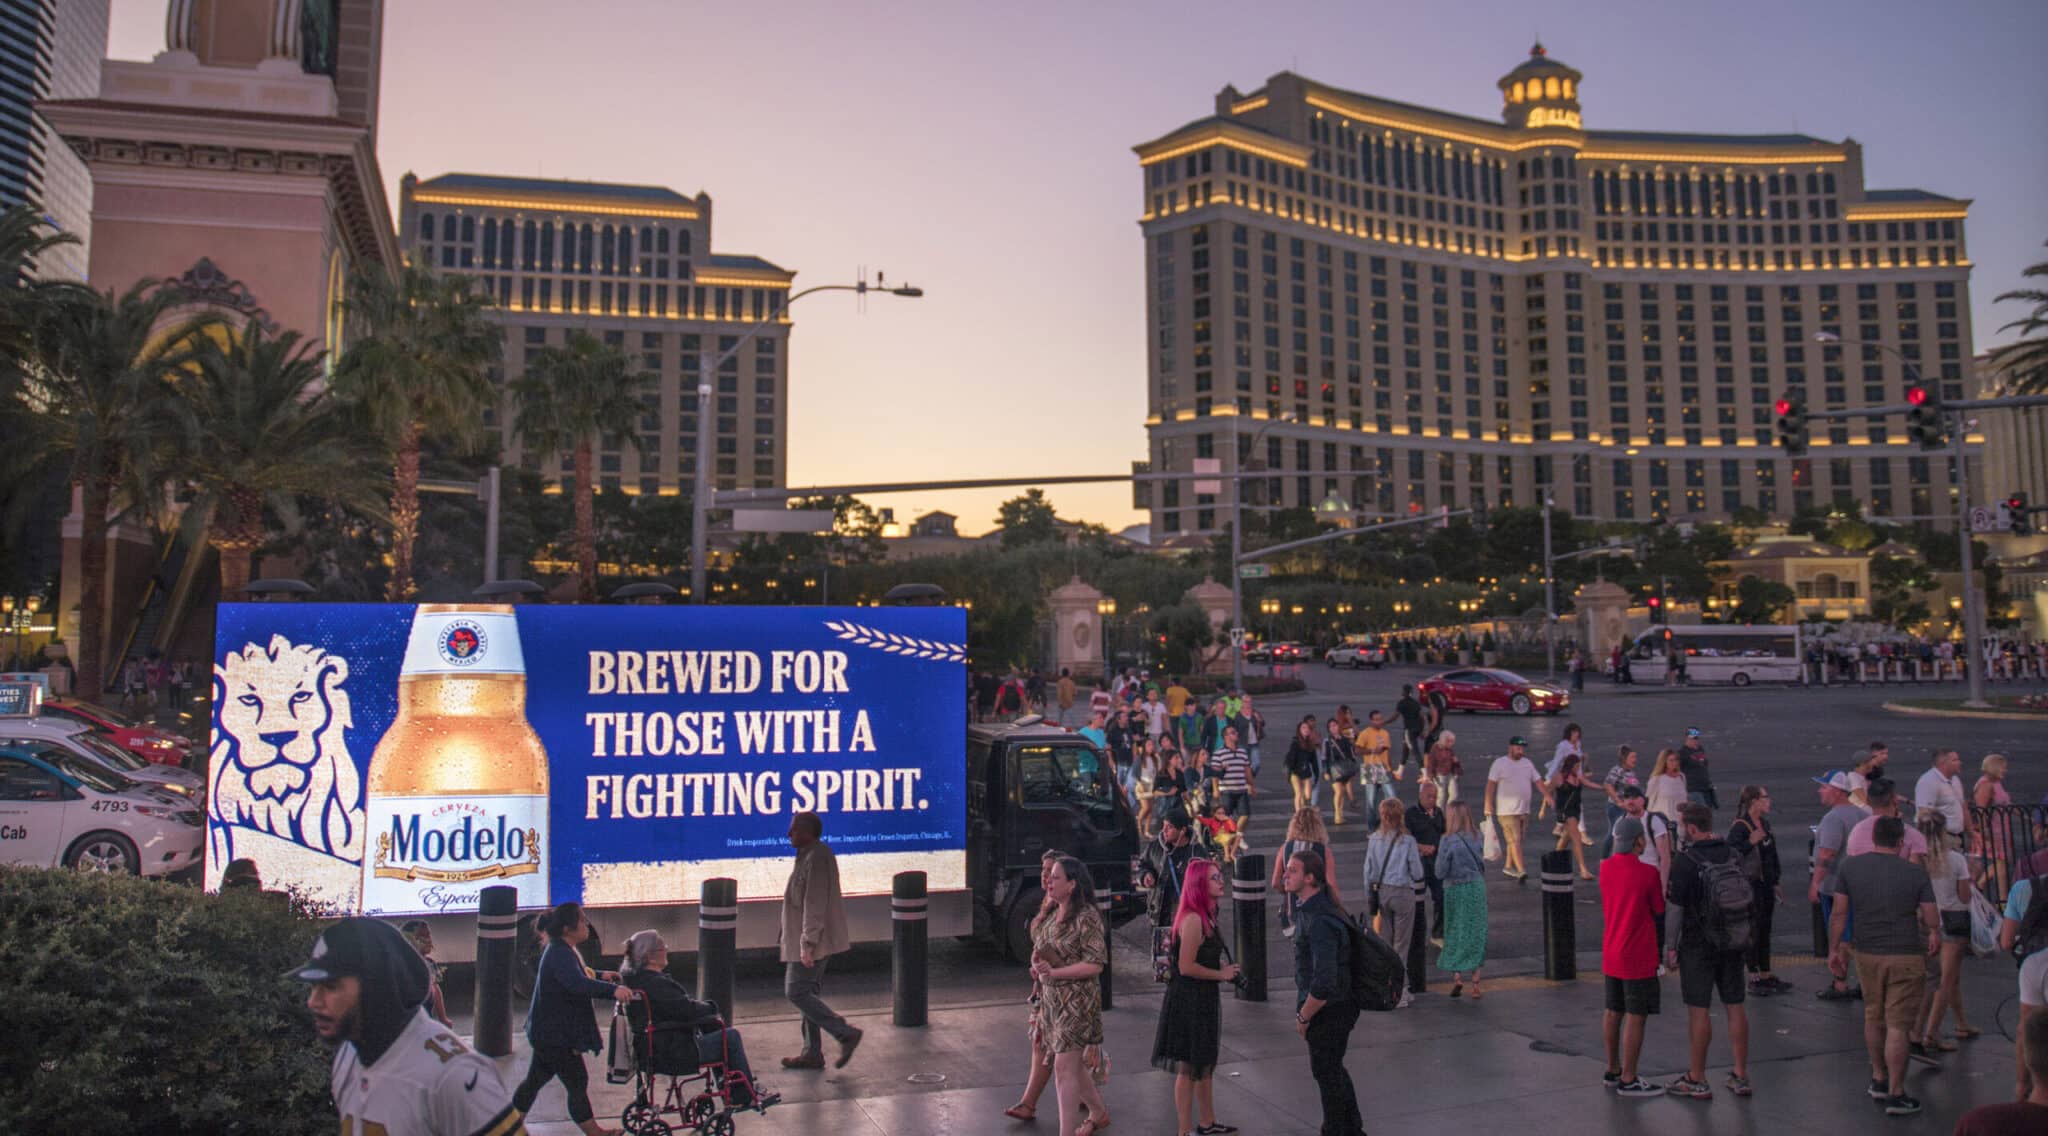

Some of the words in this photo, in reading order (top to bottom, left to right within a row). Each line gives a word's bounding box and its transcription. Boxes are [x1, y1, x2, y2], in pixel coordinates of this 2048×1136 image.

[588, 650, 762, 694] BREWED
[770, 650, 850, 693] FOR
[586, 711, 725, 756] THOSE
[733, 710, 841, 755] WITH
[849, 709, 877, 752] A
[91, 800, 129, 813] 4793
[585, 771, 782, 819] FIGHTING
[791, 768, 929, 813] SPIRIT.
[431, 803, 486, 817] CERVEZA
[1, 825, 27, 840] Cab
[391, 814, 525, 862] Modelo
[446, 873, 469, 881] 1925
[418, 885, 481, 911] Especi
[424, 1032, 470, 1064] 13
